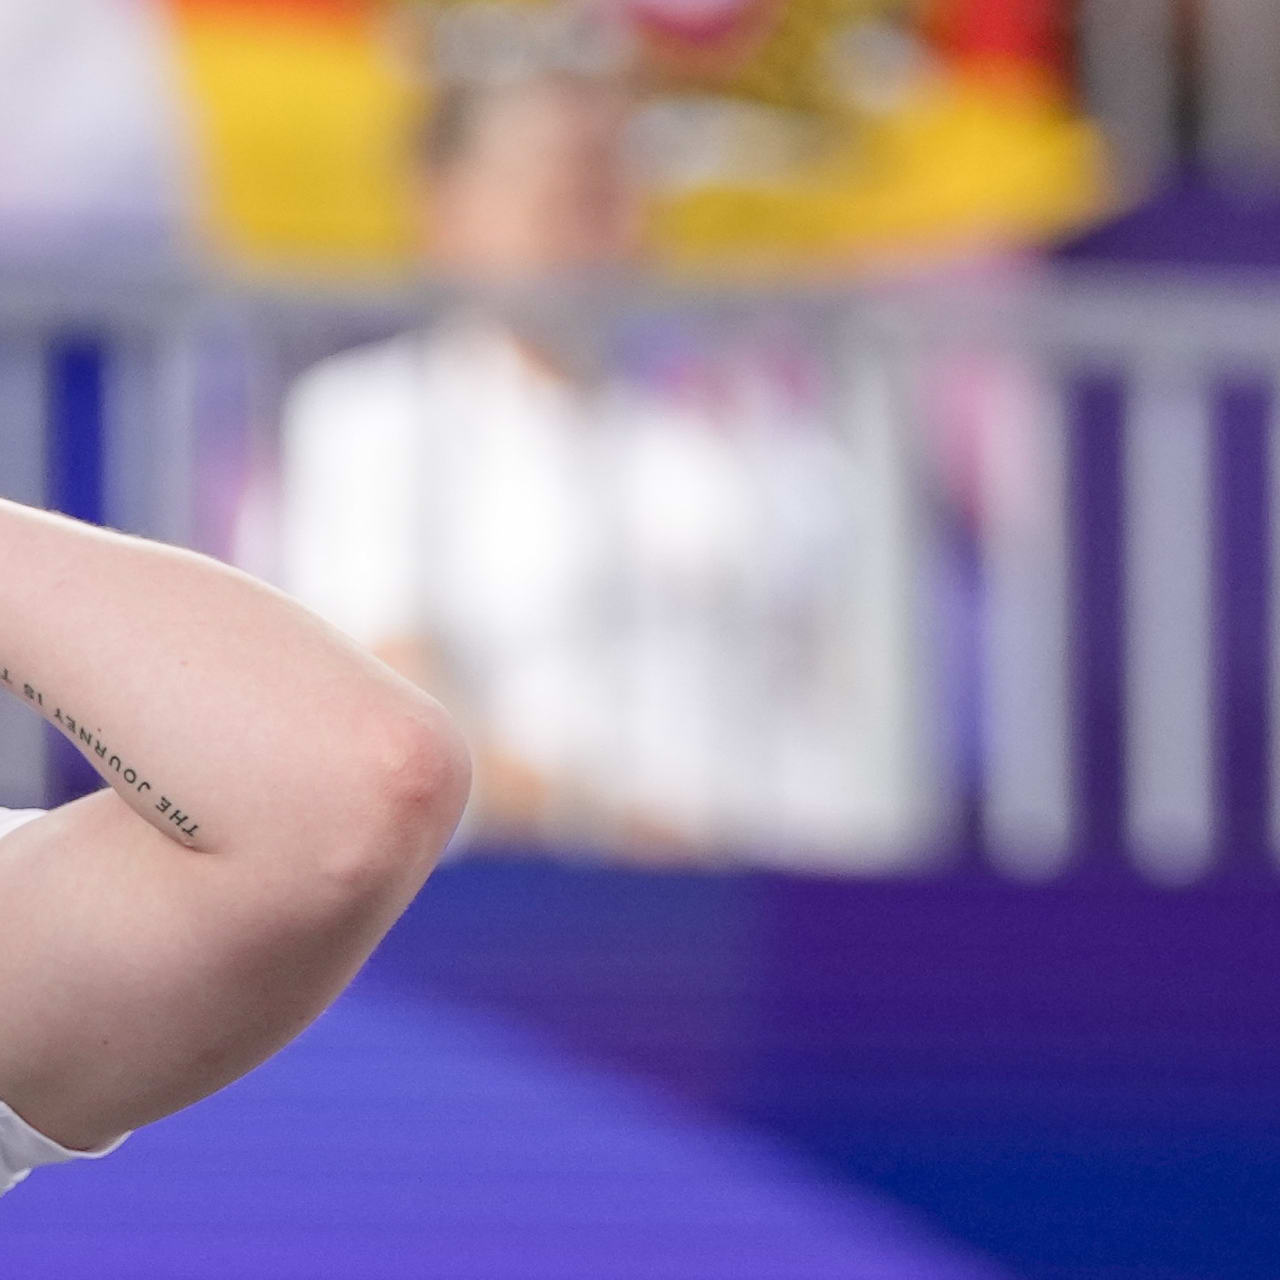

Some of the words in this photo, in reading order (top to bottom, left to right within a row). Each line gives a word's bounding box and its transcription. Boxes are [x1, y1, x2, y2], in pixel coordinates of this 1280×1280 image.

[23, 683, 44, 706] IS
[53, 707, 152, 793] JOURNEY
[155, 796, 199, 838] THE
